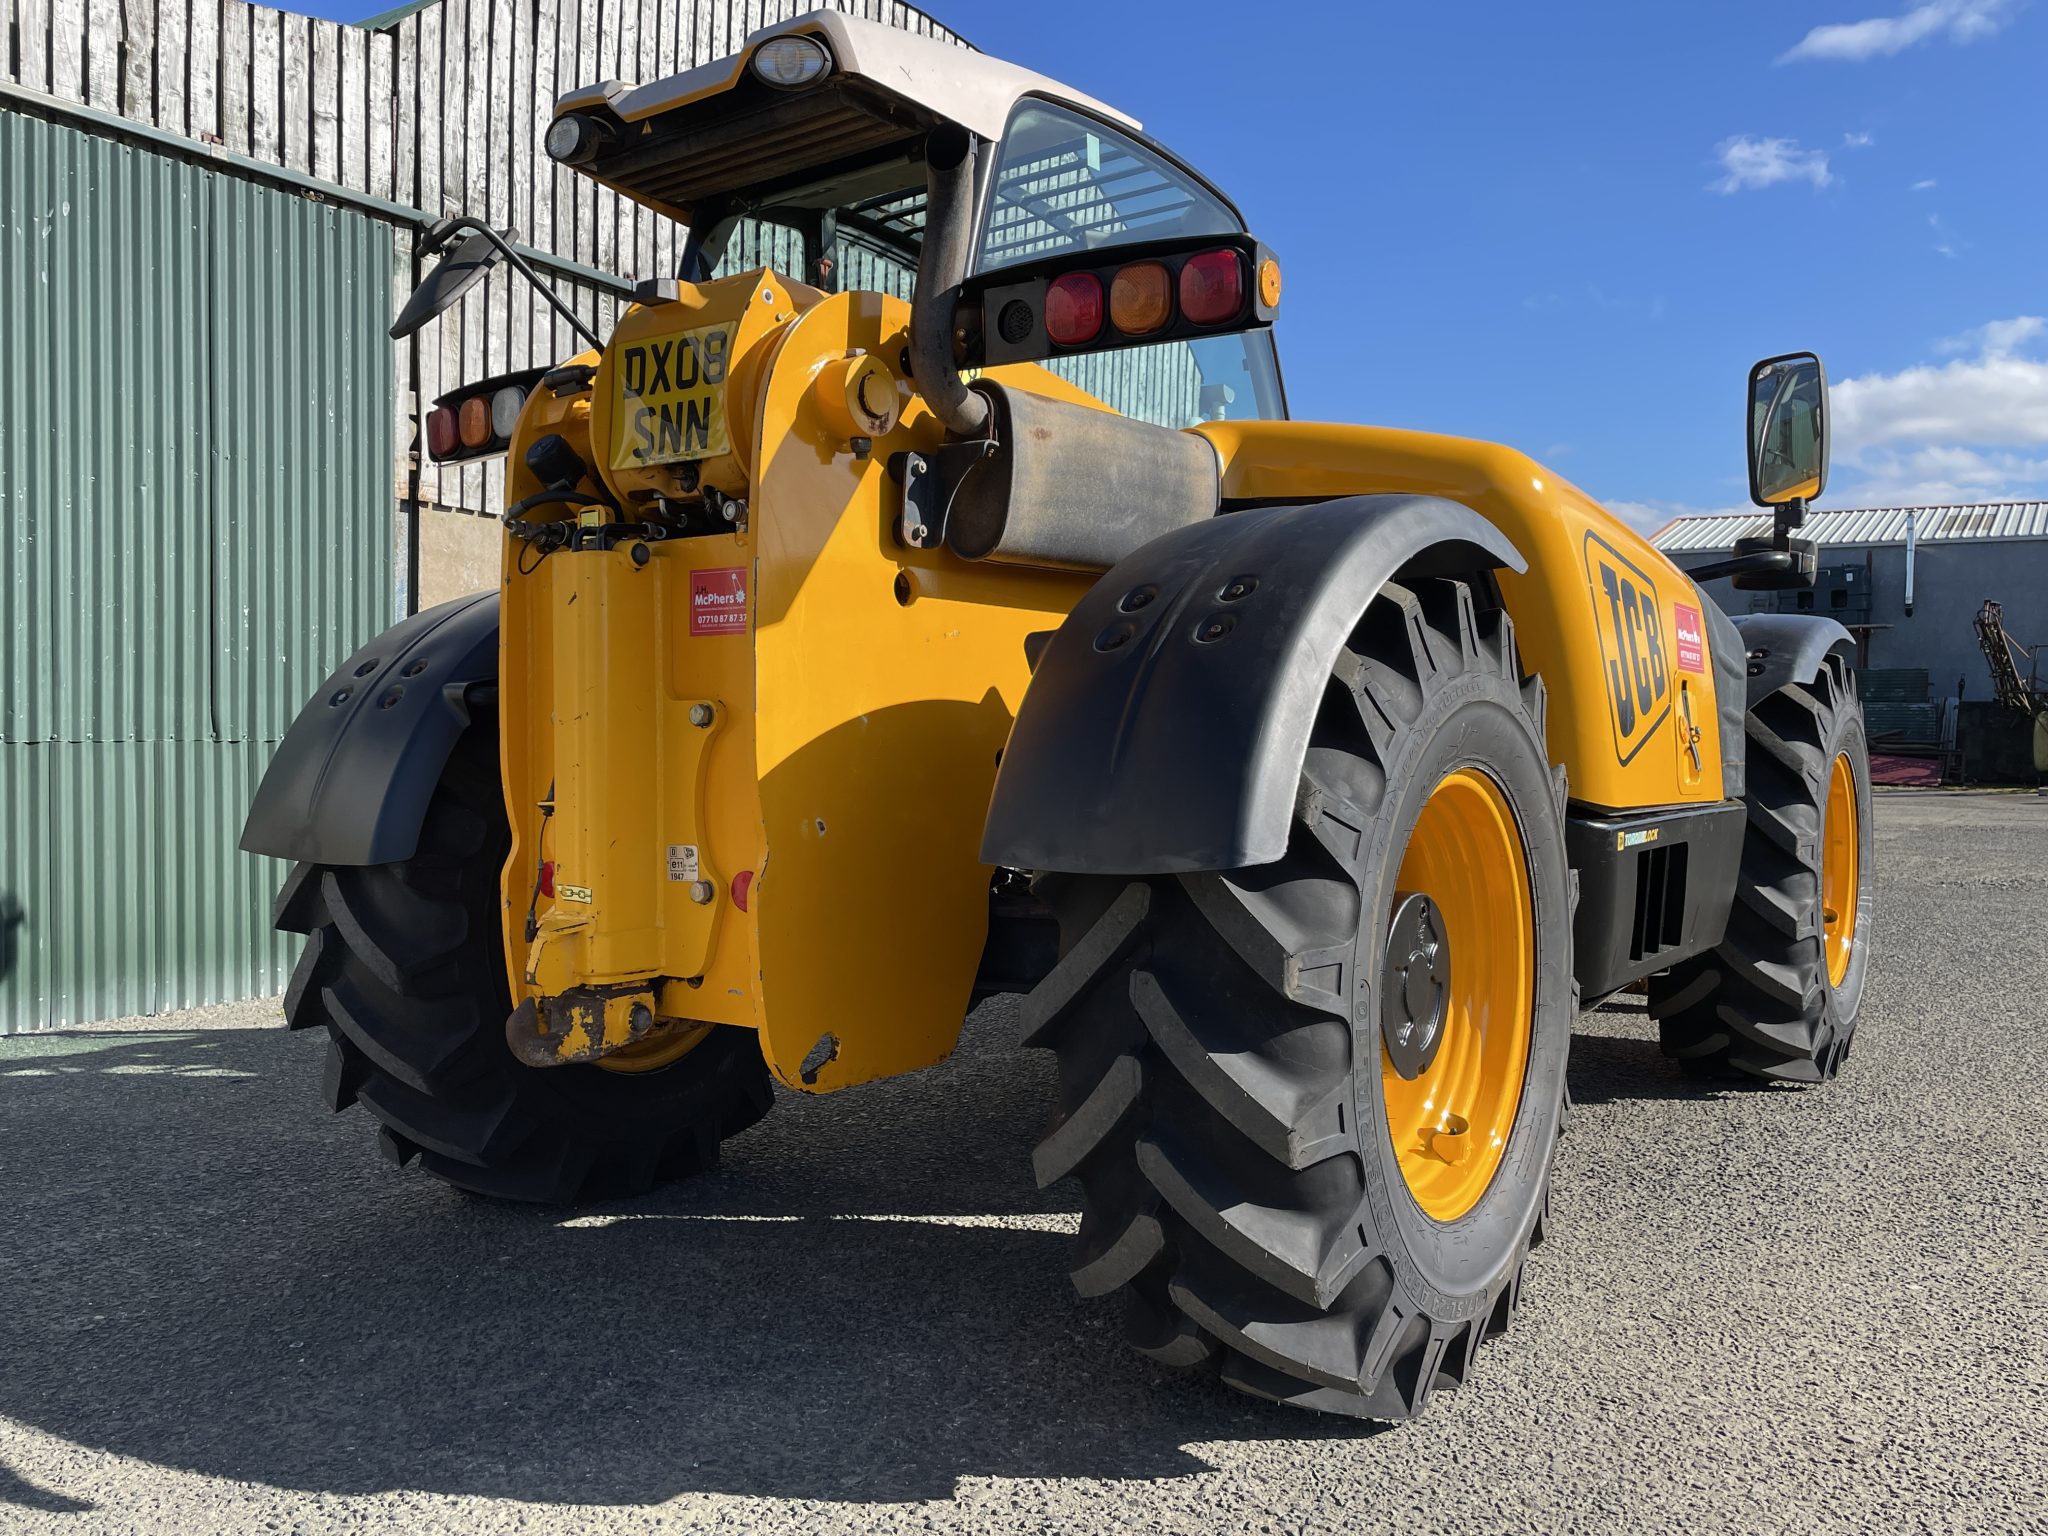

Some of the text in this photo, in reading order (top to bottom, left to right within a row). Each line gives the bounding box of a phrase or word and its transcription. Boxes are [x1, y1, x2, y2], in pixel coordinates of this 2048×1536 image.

[623, 330, 728, 400] DX08
[633, 397, 711, 459] SNN
[698, 615, 718, 624] 07710
[720, 614, 728, 623] 87
[729, 614, 738, 622] 87
[1598, 559, 1666, 739] JCB
